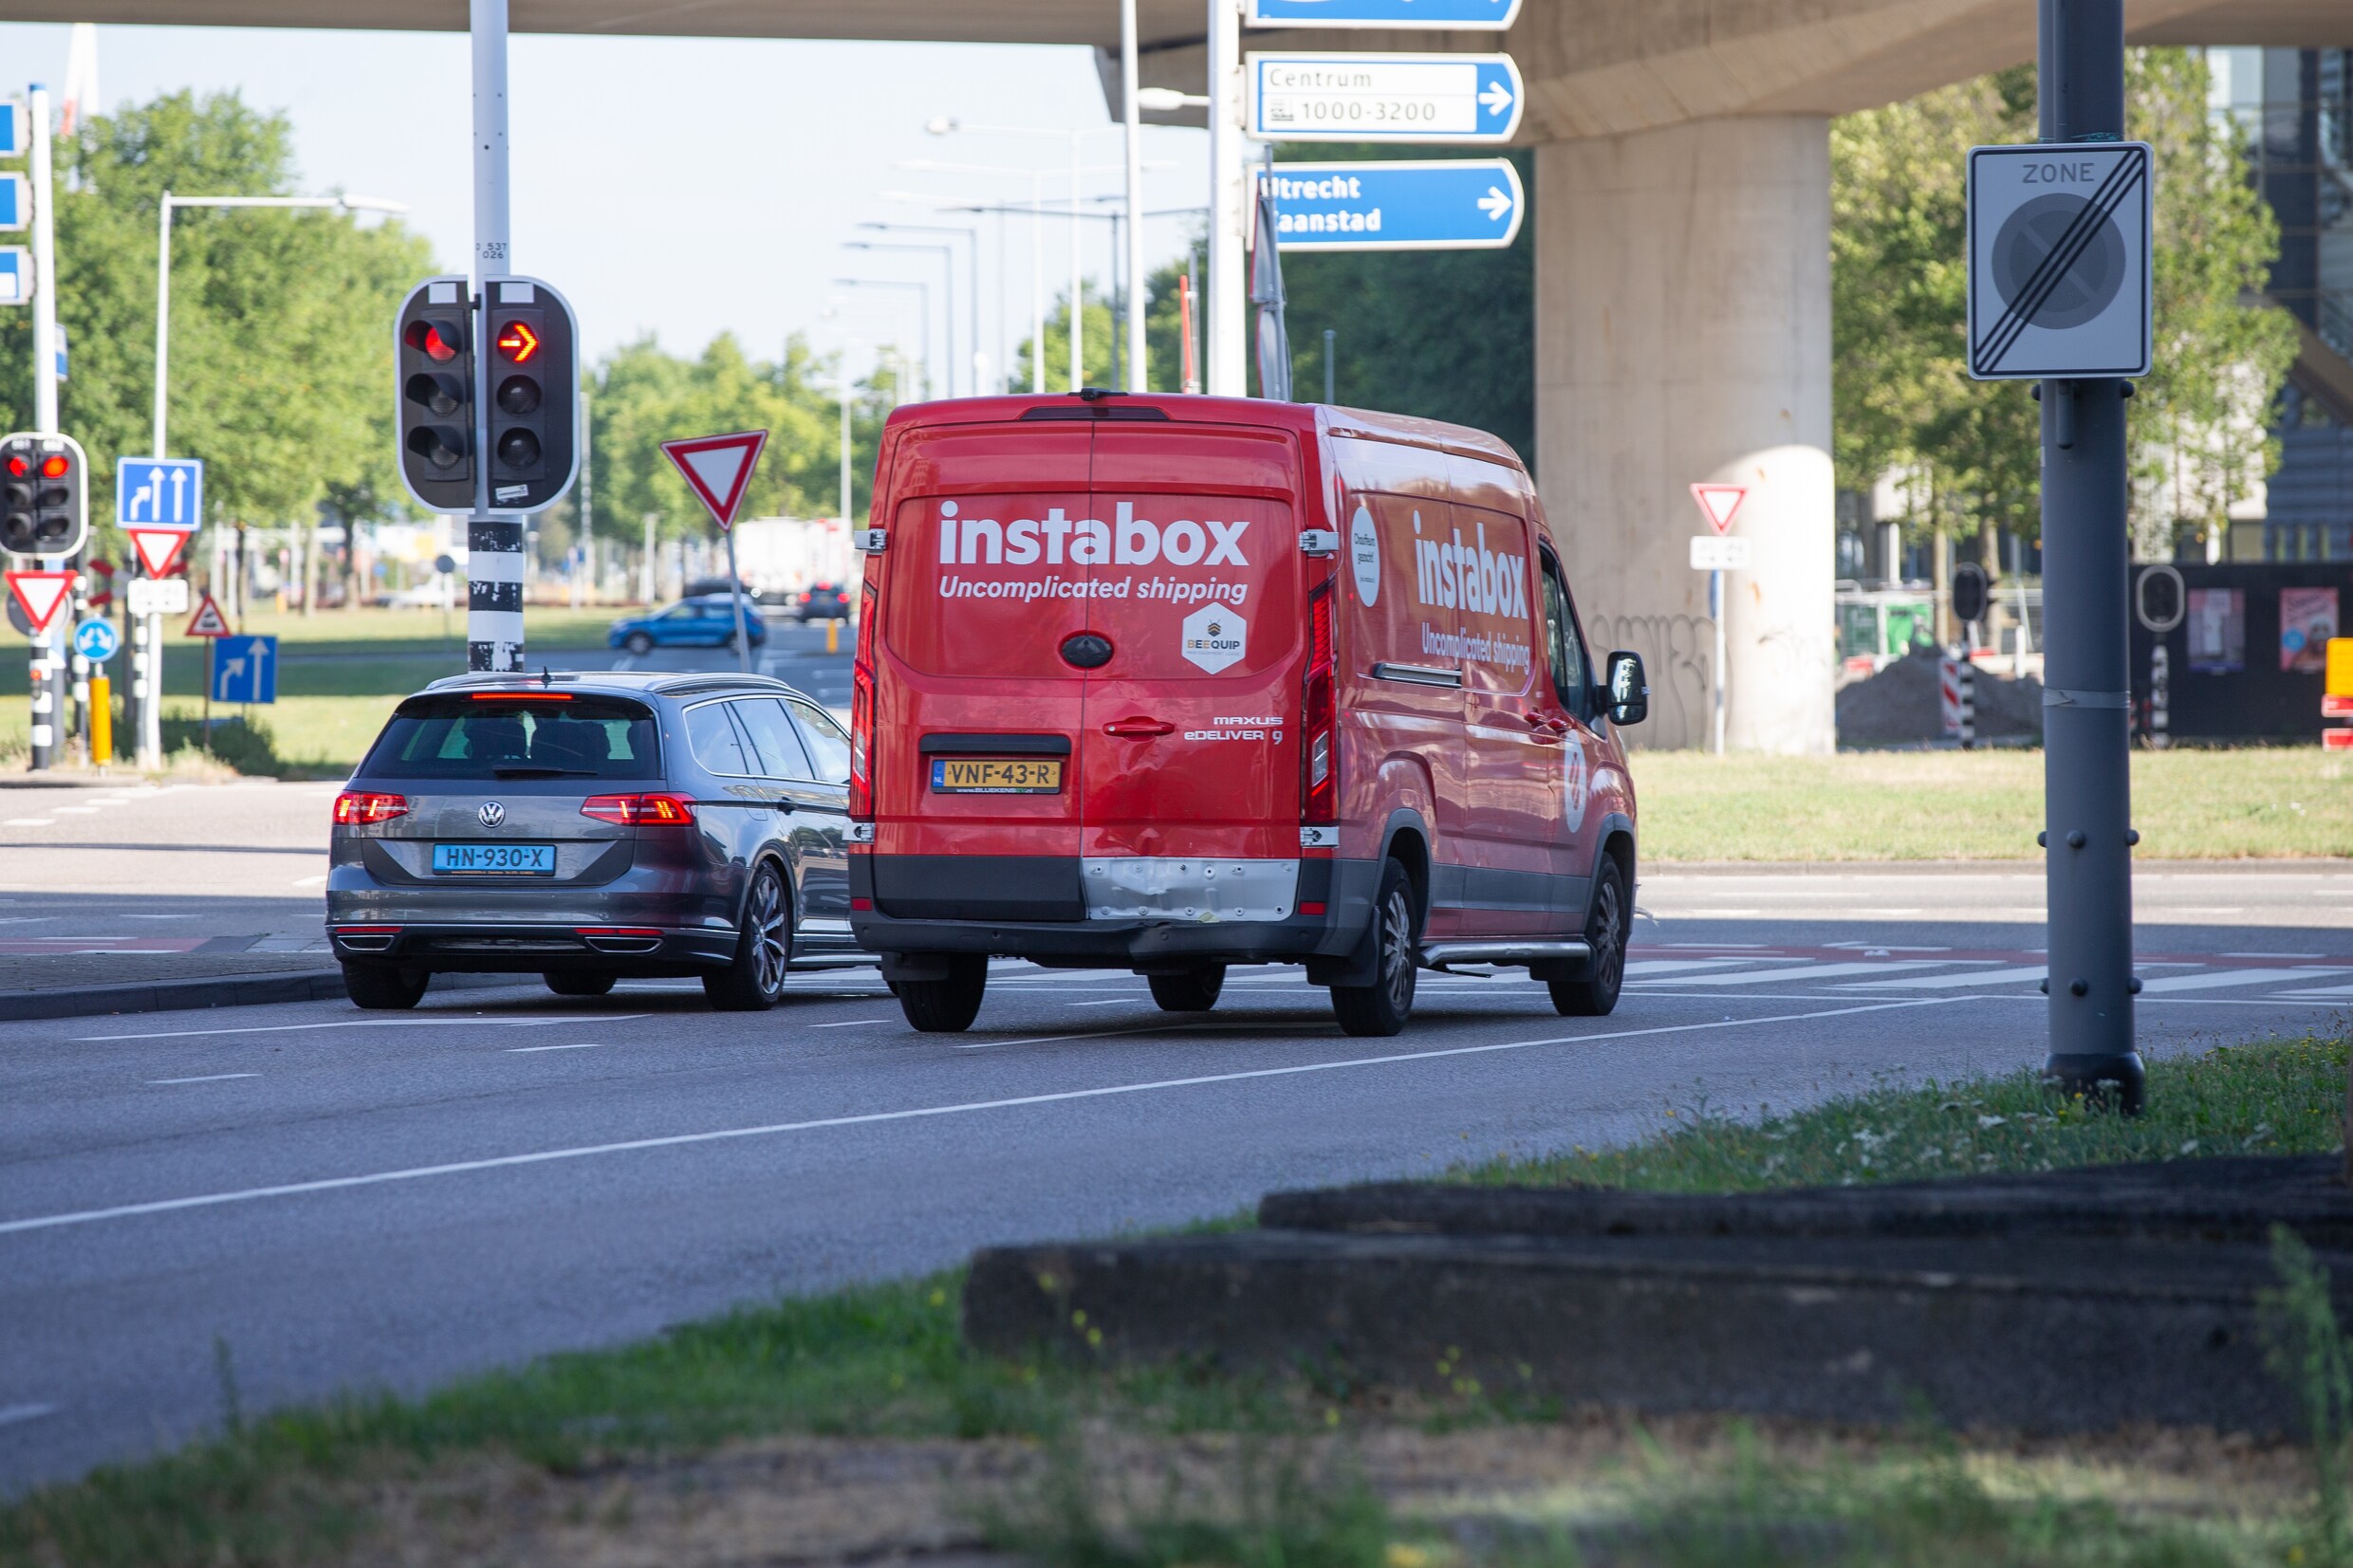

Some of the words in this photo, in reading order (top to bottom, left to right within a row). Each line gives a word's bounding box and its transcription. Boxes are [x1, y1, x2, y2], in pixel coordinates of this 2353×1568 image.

[1269, 68, 1371, 87] Centrum
[1303, 101, 1436, 120] 1000-3200
[2022, 162, 2095, 183] ZONE
[488, 242, 507, 250] 537
[939, 500, 1251, 565] instabox
[1413, 509, 1529, 619] instabox
[939, 575, 1131, 602] Uncomplicated
[1137, 577, 1248, 605] shipping
[1187, 639, 1240, 650] BEEQUIP
[1422, 621, 1491, 665] Uncomplicated
[1493, 632, 1530, 675] shipping
[1214, 716, 1284, 726] MAXUS
[1183, 729, 1265, 741] eDELIVER
[1272, 730, 1283, 746] 9
[952, 764, 1049, 784] VNF-43-R
[447, 848, 544, 867] HN-930-X
